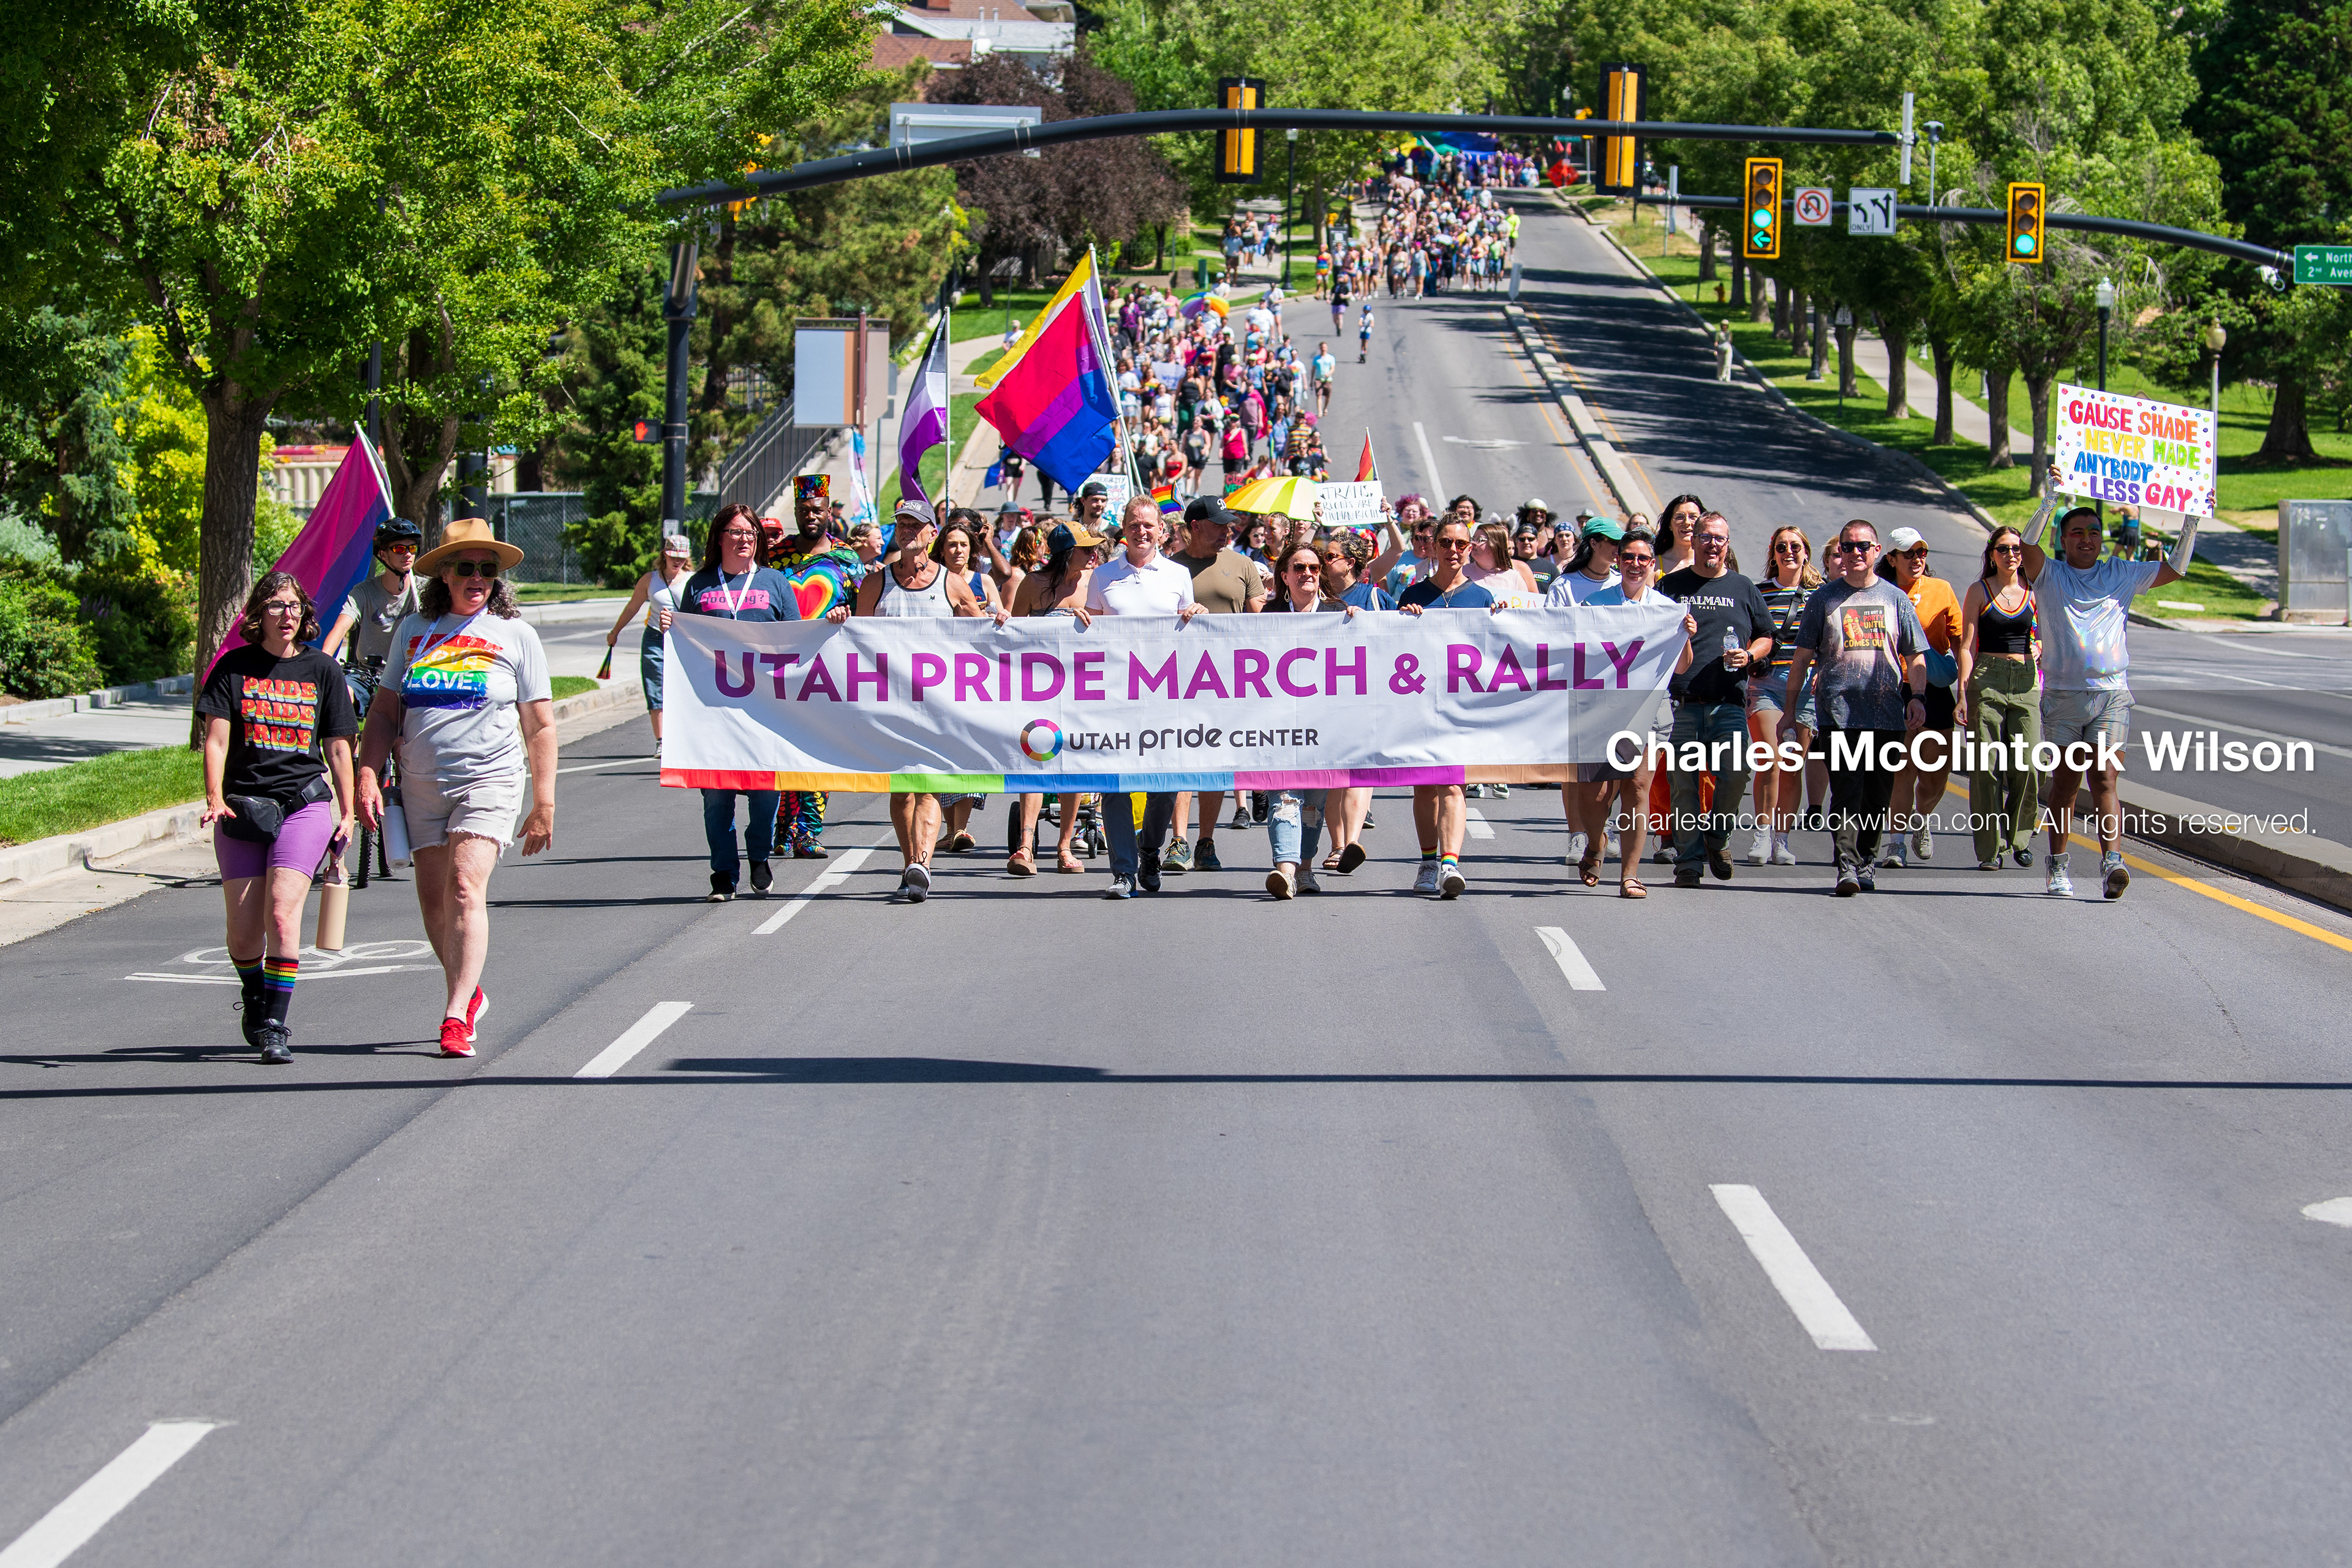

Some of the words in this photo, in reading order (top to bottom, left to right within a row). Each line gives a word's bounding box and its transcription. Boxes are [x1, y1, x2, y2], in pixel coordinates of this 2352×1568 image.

[2307, 266, 2323, 277] 2nd
[2069, 400, 2133, 432] CAUSE
[2138, 412, 2198, 444] SHADE
[2084, 428, 2146, 460] NEVER
[2152, 439, 2201, 470] MADE
[1226, 475, 1245, 486] CUZ
[2075, 451, 2154, 483] ANYBODY
[1217, 498, 1227, 510] D
[1322, 484, 1369, 499] TRANS
[1323, 500, 1354, 511] RIGHTS
[1358, 499, 1373, 508] ARE
[2090, 475, 2140, 504] LESS
[2146, 483, 2193, 512] GAY
[1325, 510, 1354, 522] HUMAN
[1680, 595, 1735, 607] BALMAIN
[1844, 639, 1870, 648] COMES
[1872, 639, 1885, 647] OUT
[714, 649, 889, 703] UTAH
[911, 651, 1106, 703] PRIDE
[1128, 646, 1368, 701] MARCH
[1389, 653, 1426, 695] &
[1446, 640, 1646, 693] RALLY
[242, 675, 318, 705] PRIDE
[241, 699, 316, 729] PRIDE
[243, 723, 312, 755] PRIDE
[1069, 732, 1129, 750] UTAH
[1139, 724, 1223, 756] pride
[1229, 728, 1319, 748] CENTER
